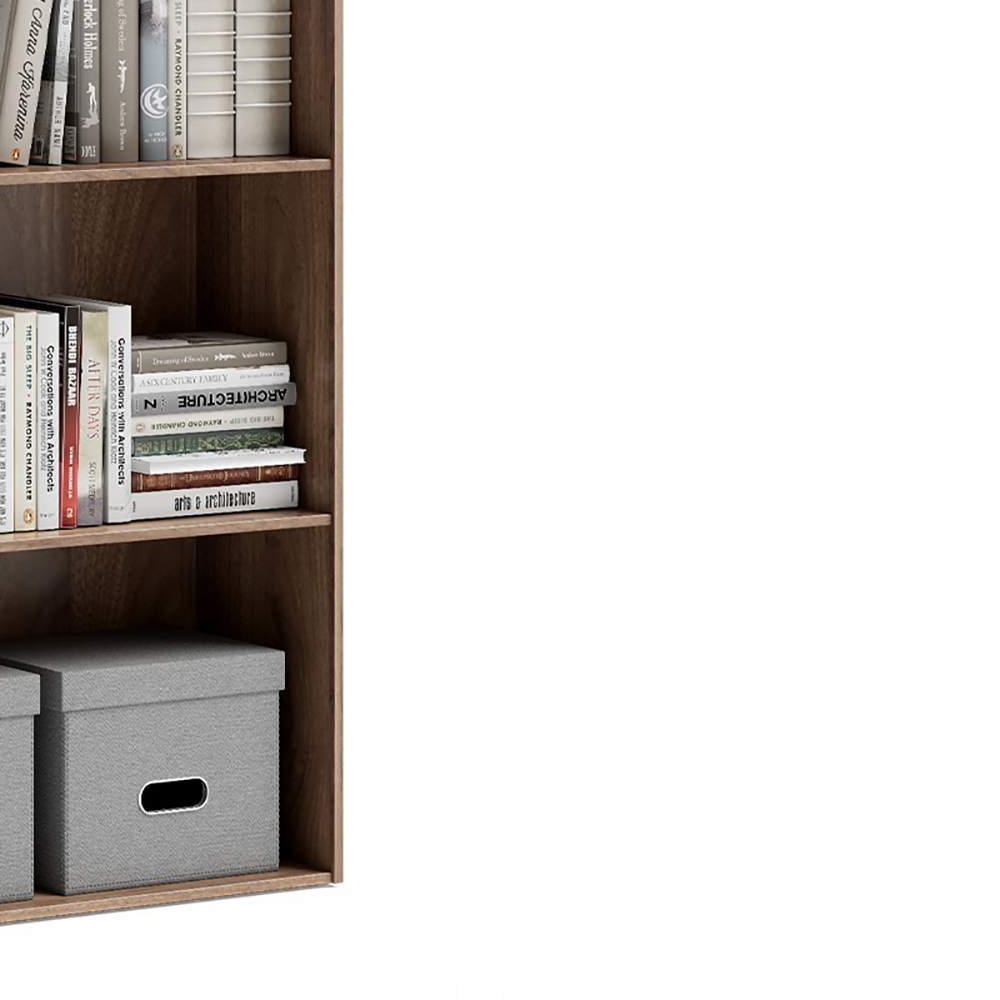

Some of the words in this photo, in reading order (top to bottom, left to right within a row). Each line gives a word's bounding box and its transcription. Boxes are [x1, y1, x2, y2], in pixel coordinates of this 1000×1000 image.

[25, 7, 43, 55] Anna
[117, 8, 127, 17] of
[174, 1, 182, 27] SLEEP
[83, 32, 98, 70] Holmes
[118, 18, 127, 52] Sweden
[174, 38, 182, 86] RAYMOND
[12, 60, 35, 141] Karenina
[174, 88, 182, 136] CHANDLER
[67, 325, 77, 364] BHENDI
[47, 345, 55, 417] Conversations
[67, 367, 77, 406] BAZAAR
[88, 359, 101, 400] AFTER
[118, 338, 126, 410] Conversations
[147, 377, 161, 387] SIX
[161, 375, 198, 386] CENTURY
[199, 373, 229, 384] FAMILY
[178, 388, 287, 408] ARCHITECTURE
[47, 419, 55, 440] with
[87, 405, 101, 439] DAYS
[118, 412, 126, 433] with
[151, 421, 186, 430] CHANDLER
[188, 418, 222, 428] RAYMOND
[47, 443, 55, 492] Architects
[118, 435, 126, 485] Architects
[174, 494, 191, 511] arts
[205, 490, 256, 509] architecture
